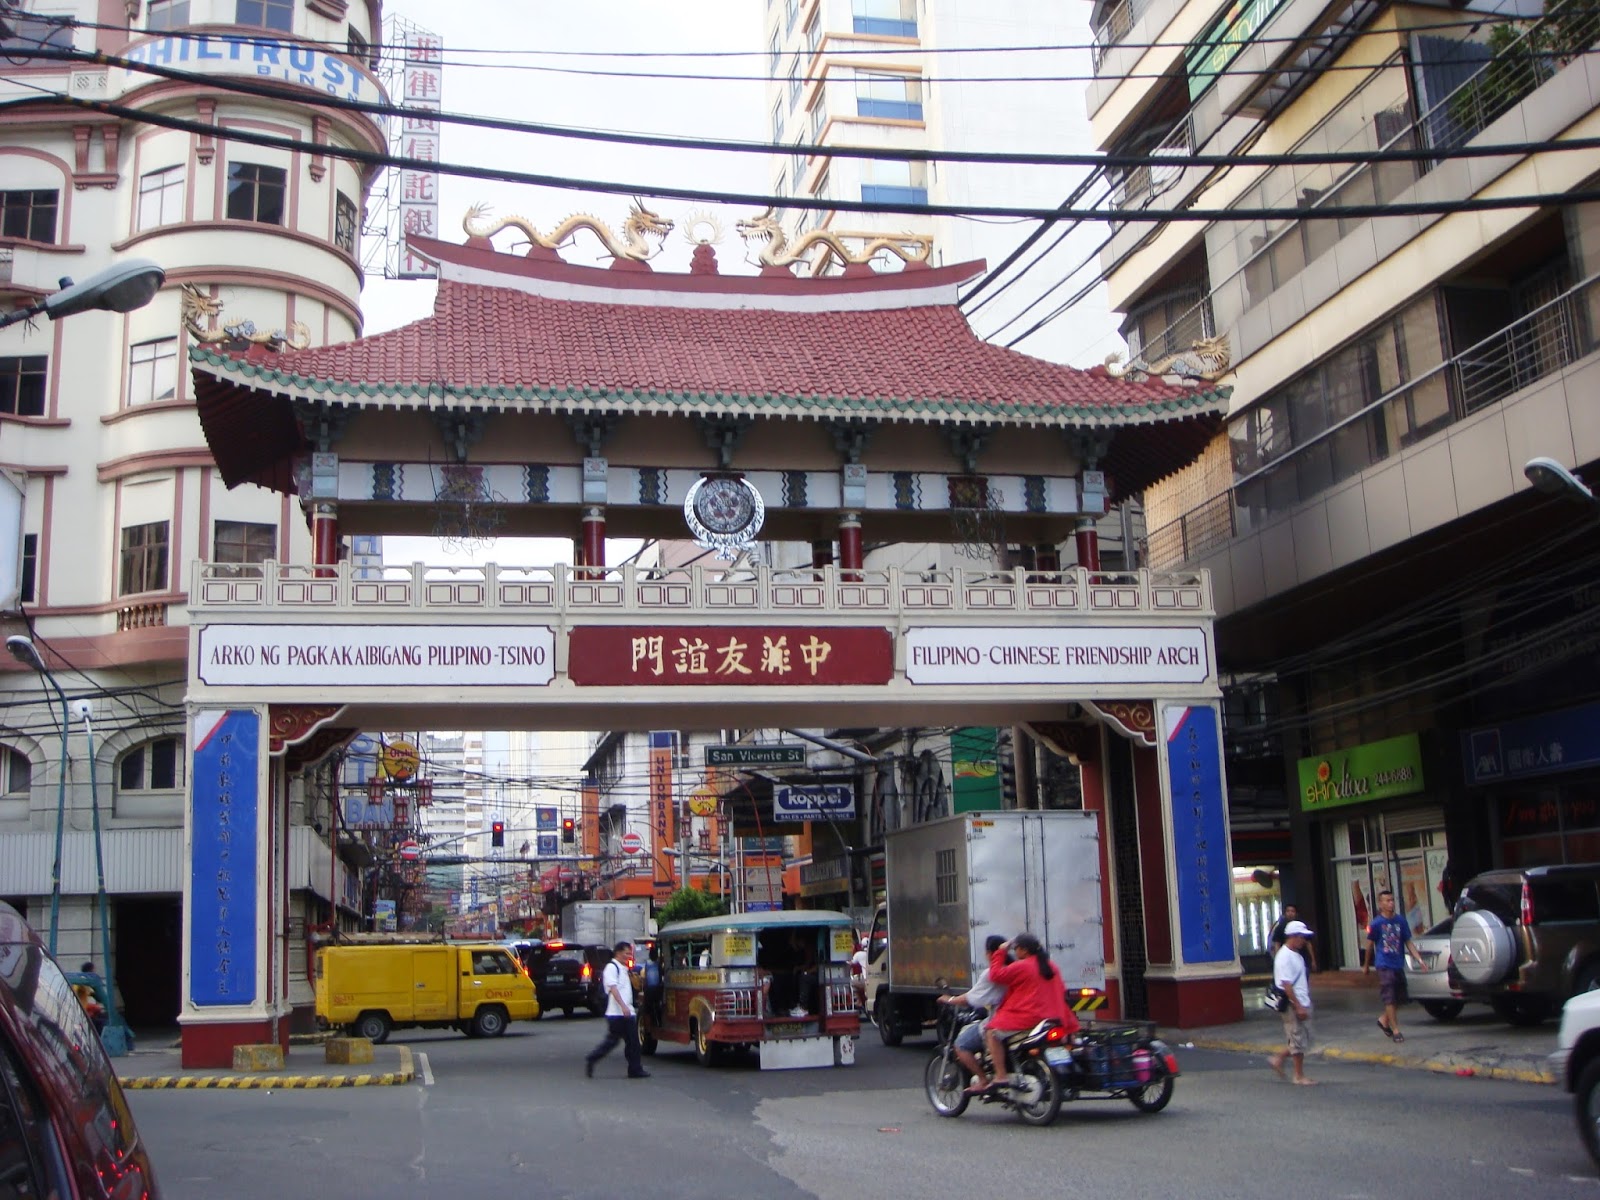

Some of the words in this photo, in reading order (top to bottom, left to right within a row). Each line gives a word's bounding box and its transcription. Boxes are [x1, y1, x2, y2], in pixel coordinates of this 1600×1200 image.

[210, 644, 255, 666] ARKO
[260, 645, 280, 666] NG
[287, 645, 422, 666] PAGKAKAIBIGANG
[913, 645, 1060, 666] FILIPINO-CHINESE
[1066, 646, 1152, 666] FRIENDSHIP
[1157, 646, 1200, 666] ARCH
[712, 751, 734, 762] San
[739, 750, 782, 761] Vicente
[788, 750, 800, 761] St
[656, 756, 668, 837] UNIONBANK
[788, 788, 841, 809] koppel
